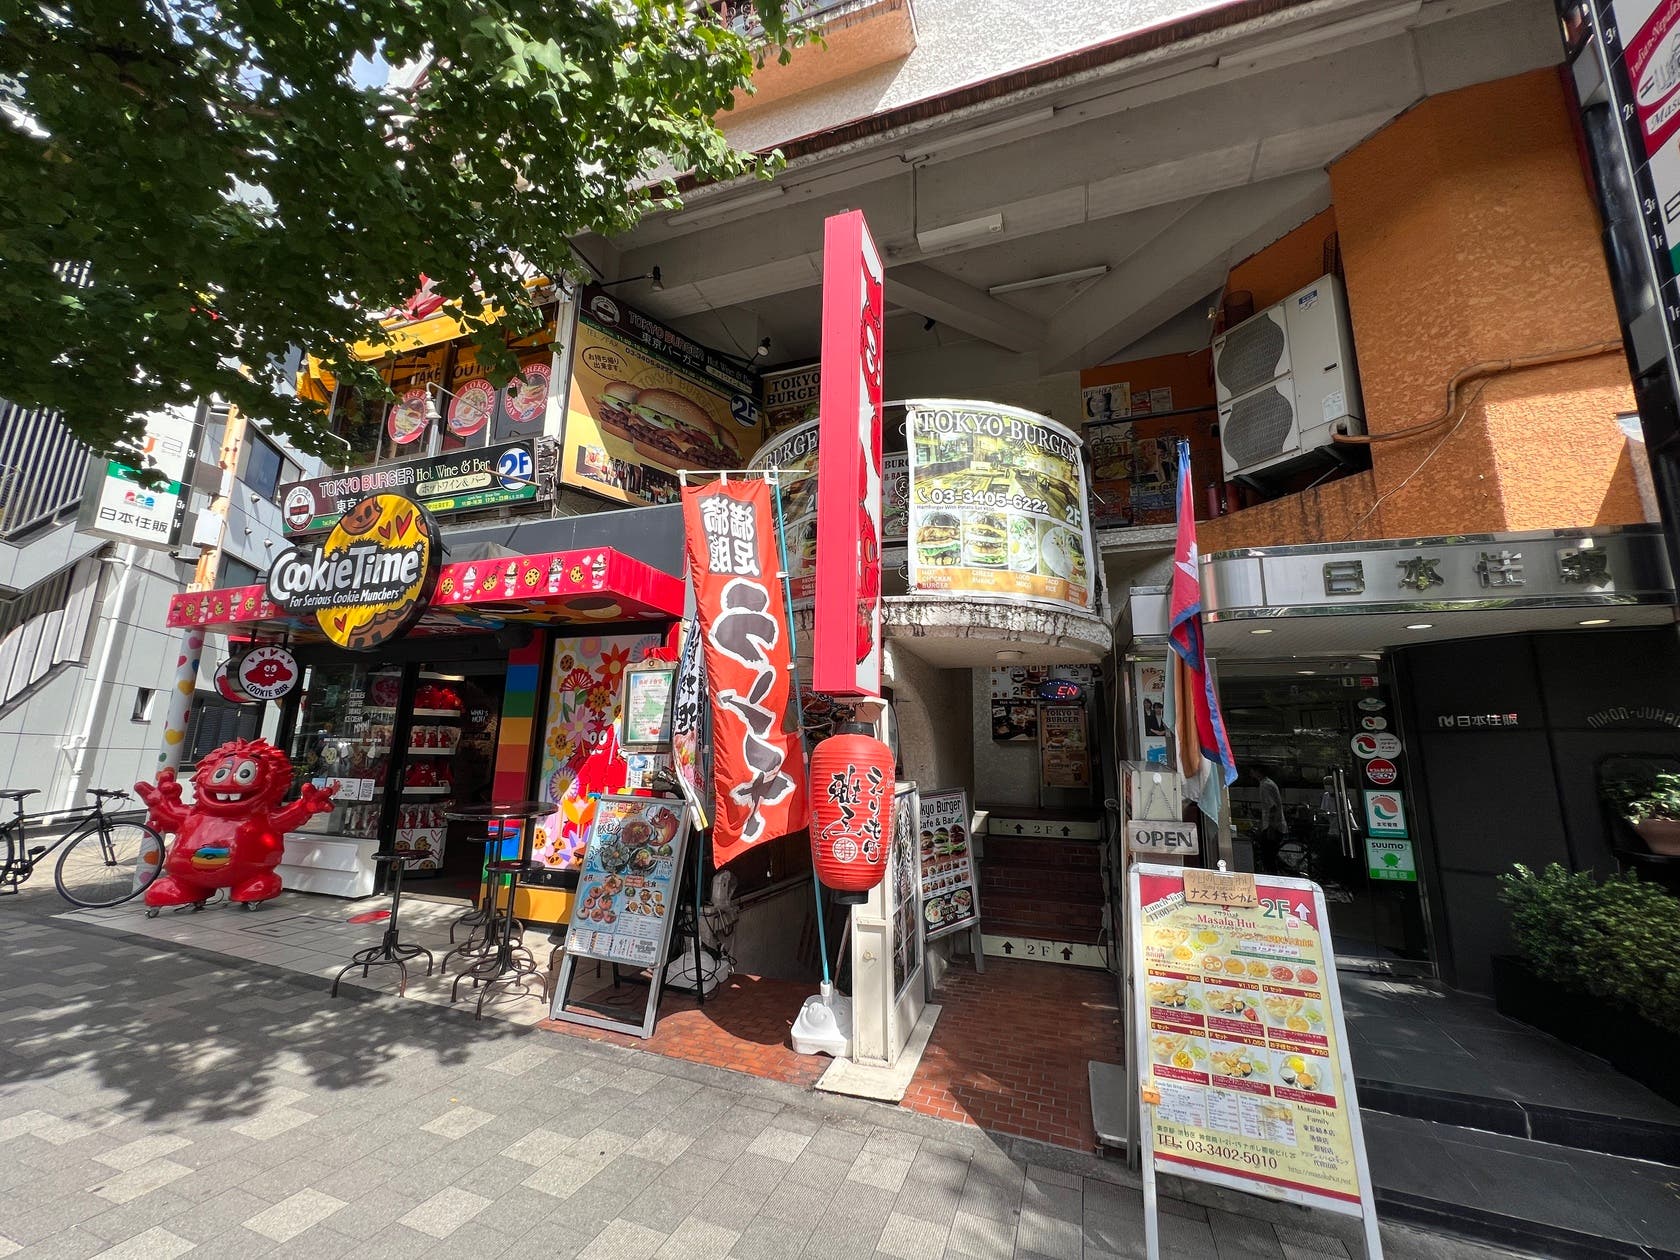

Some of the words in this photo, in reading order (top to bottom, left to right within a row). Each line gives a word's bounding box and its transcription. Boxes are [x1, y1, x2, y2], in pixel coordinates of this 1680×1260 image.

[641, 332, 702, 369] 東京バーガー
[771, 373, 820, 392] TOKYO
[732, 396, 758, 421] 2F
[916, 410, 1003, 437] TOKYO
[1010, 419, 1079, 465] BURGER
[500, 452, 529, 482] 2F
[319, 477, 360, 498] TOKYO
[362, 467, 414, 492] BURGER
[416, 468, 434, 482] Hot
[435, 464, 458, 478] Wine
[461, 460, 470, 473] &
[930, 488, 1050, 515] 03-3405-6222
[100, 507, 168, 534] 日本住販
[1323, 544, 1613, 596] 日本住販
[290, 595, 302, 608] For
[303, 593, 332, 606] Serious
[333, 591, 359, 604] Cookie
[360, 587, 400, 602] Munchers
[246, 682, 273, 699] COOKIE
[274, 683, 290, 698] BAR
[709, 577, 796, 843] ランチ
[1457, 713, 1519, 728] 日本住販
[937, 798, 961, 814] Burger
[943, 815, 954, 825] Bar
[1033, 825, 1053, 834] 2F
[1135, 830, 1193, 847] OPEN
[1144, 896, 1169, 914] Lunch
[1261, 898, 1290, 919] 2F
[1197, 914, 1234, 927] Masala
[1237, 920, 1256, 929] Hut
[1027, 944, 1051, 957] 2F
[1186, 1139, 1278, 1170] 03-3402-5010
